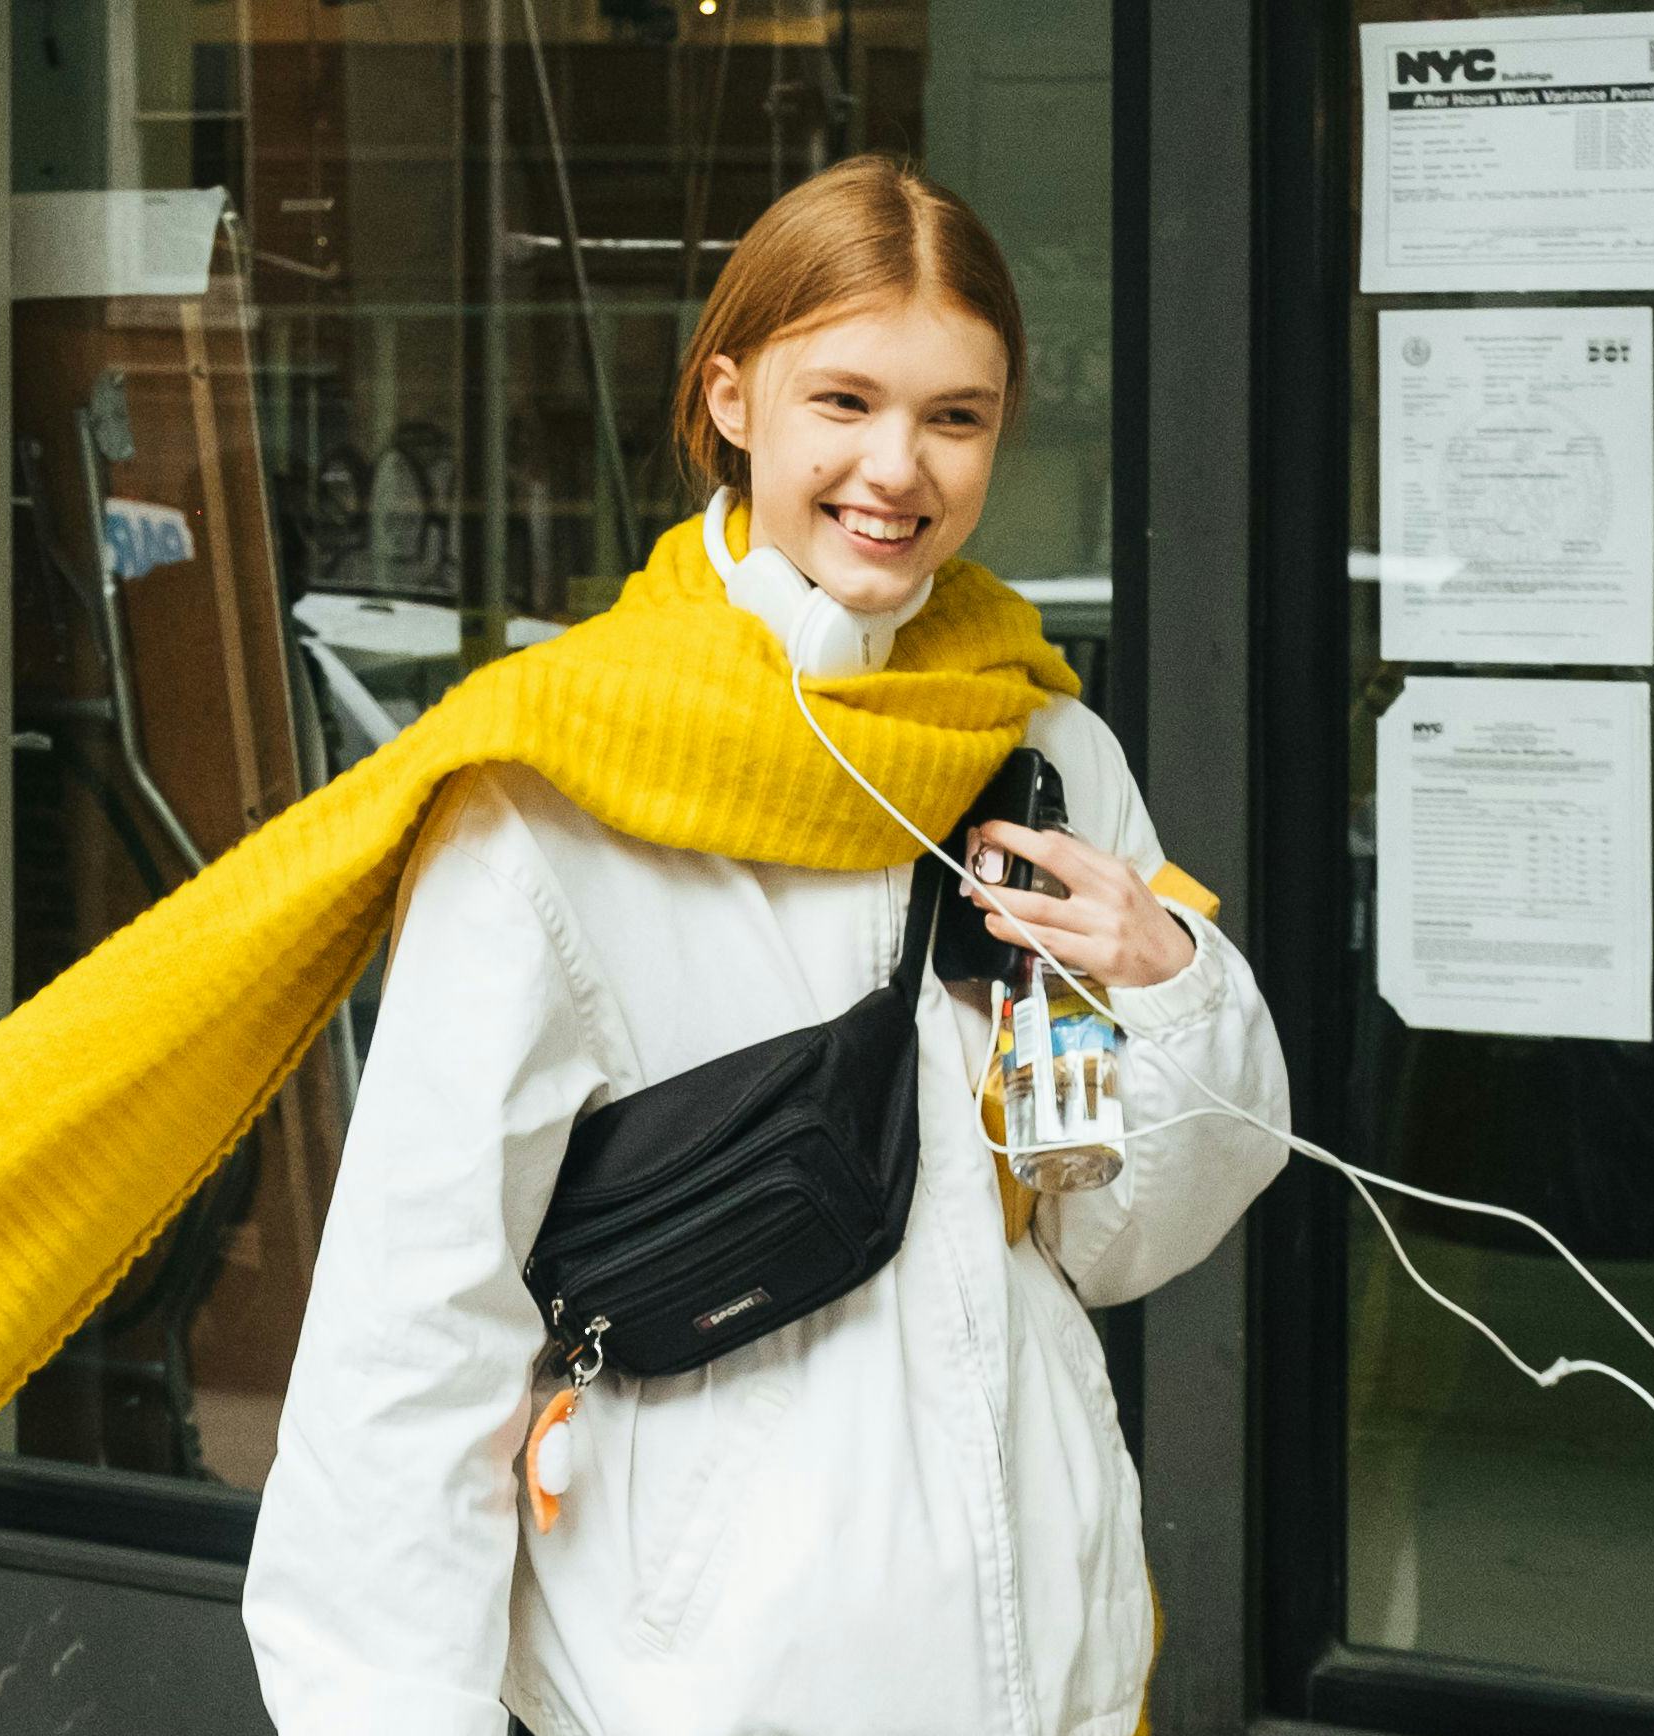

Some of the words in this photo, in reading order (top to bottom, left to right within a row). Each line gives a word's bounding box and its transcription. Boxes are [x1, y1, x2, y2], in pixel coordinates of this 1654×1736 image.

[1396, 48, 1496, 85] NYC
[1412, 93, 1449, 108] After
[1452, 91, 1497, 106] Hours
[1500, 89, 1540, 105] Work
[1542, 88, 1608, 104] Variance
